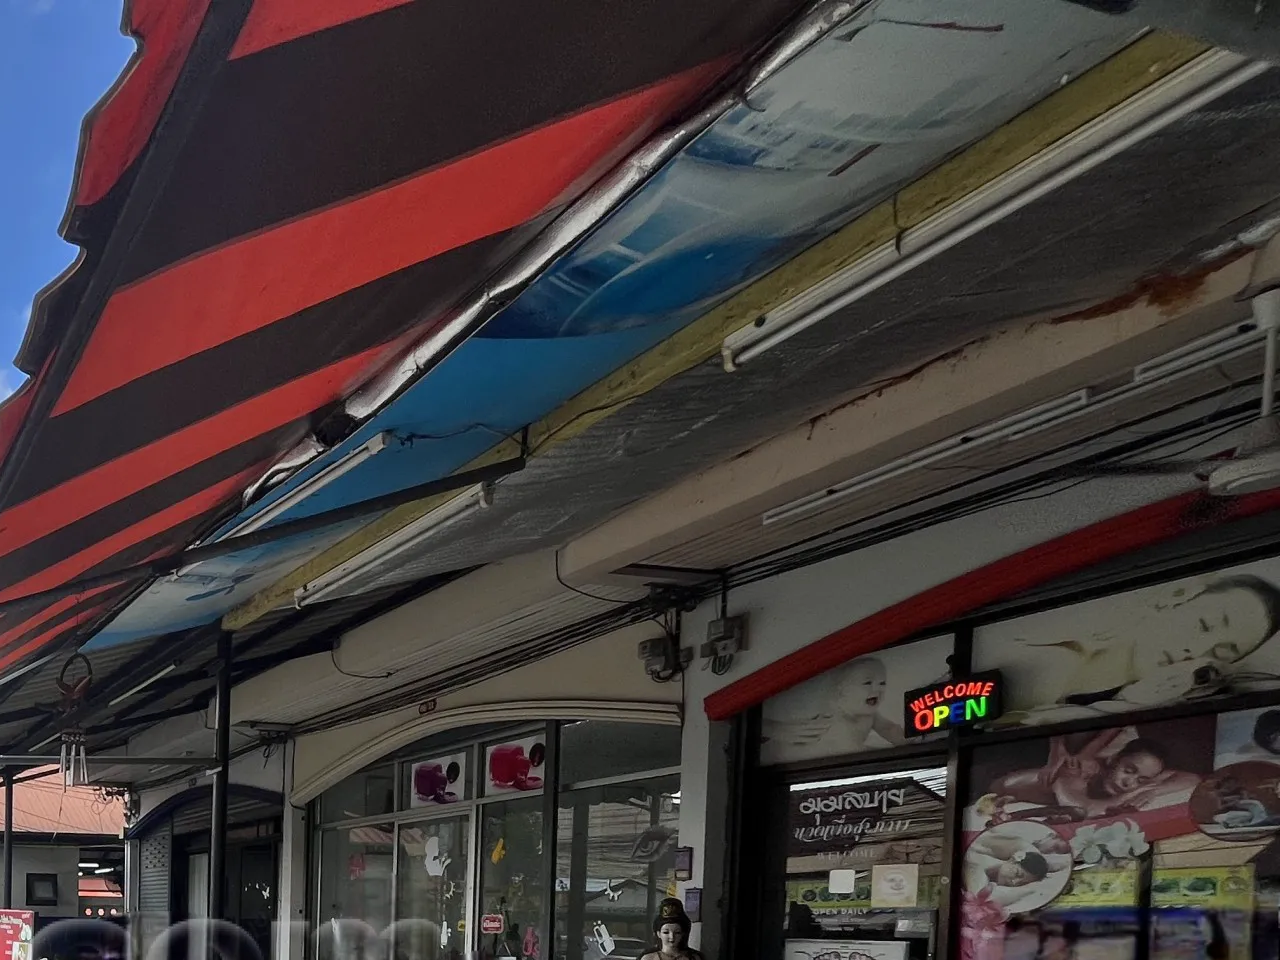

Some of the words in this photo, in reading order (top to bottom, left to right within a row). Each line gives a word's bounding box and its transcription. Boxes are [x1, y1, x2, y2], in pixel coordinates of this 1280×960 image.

[910, 682, 995, 713] WELCOME
[914, 696, 987, 731] OPEN
[816, 848, 877, 860] WELCOME
[813, 907, 838, 915] OPEN
[841, 907, 868, 915] DAILY
